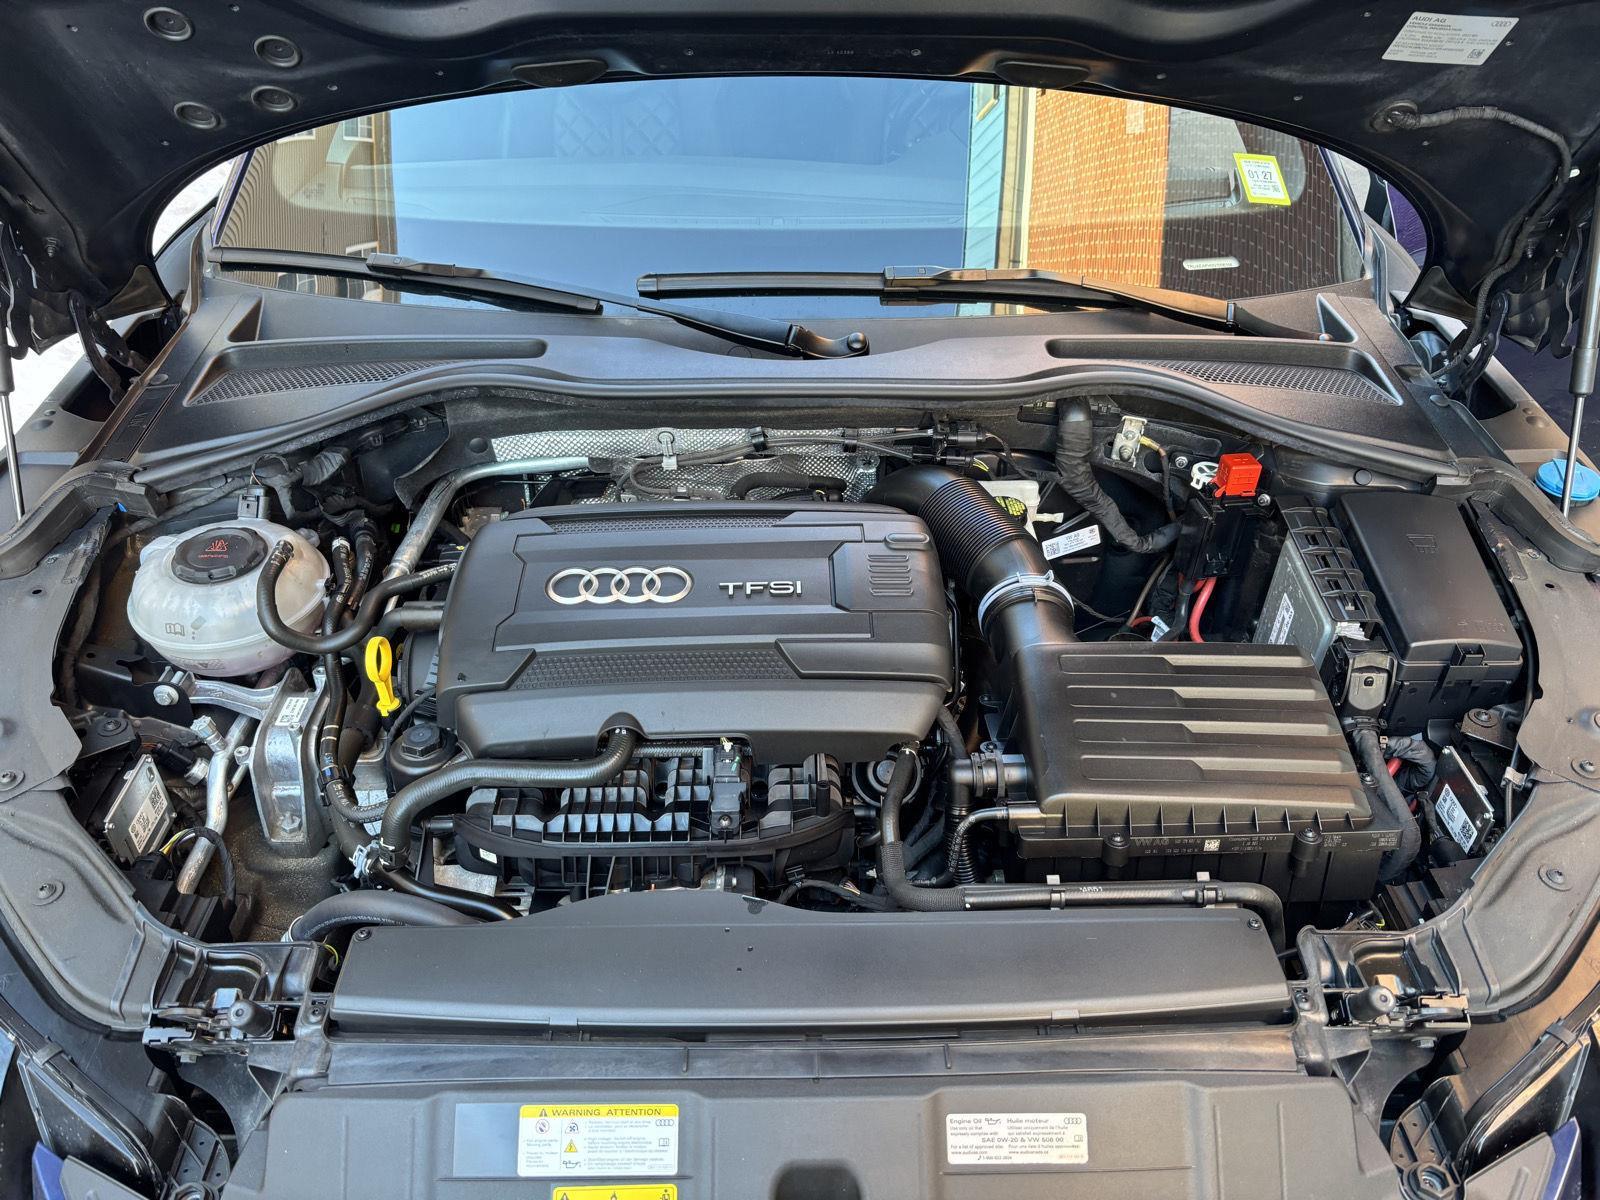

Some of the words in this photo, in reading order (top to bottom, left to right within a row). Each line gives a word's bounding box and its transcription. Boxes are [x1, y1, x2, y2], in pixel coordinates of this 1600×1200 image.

[1247, 169, 1260, 180] 01
[1261, 170, 1273, 181] 27
[719, 580, 802, 598] TFSI
[1134, 838, 1153, 847] VW
[1153, 837, 1169, 846] AG
[551, 1108, 601, 1117] WARNING
[606, 1107, 662, 1116] ATTENTION
